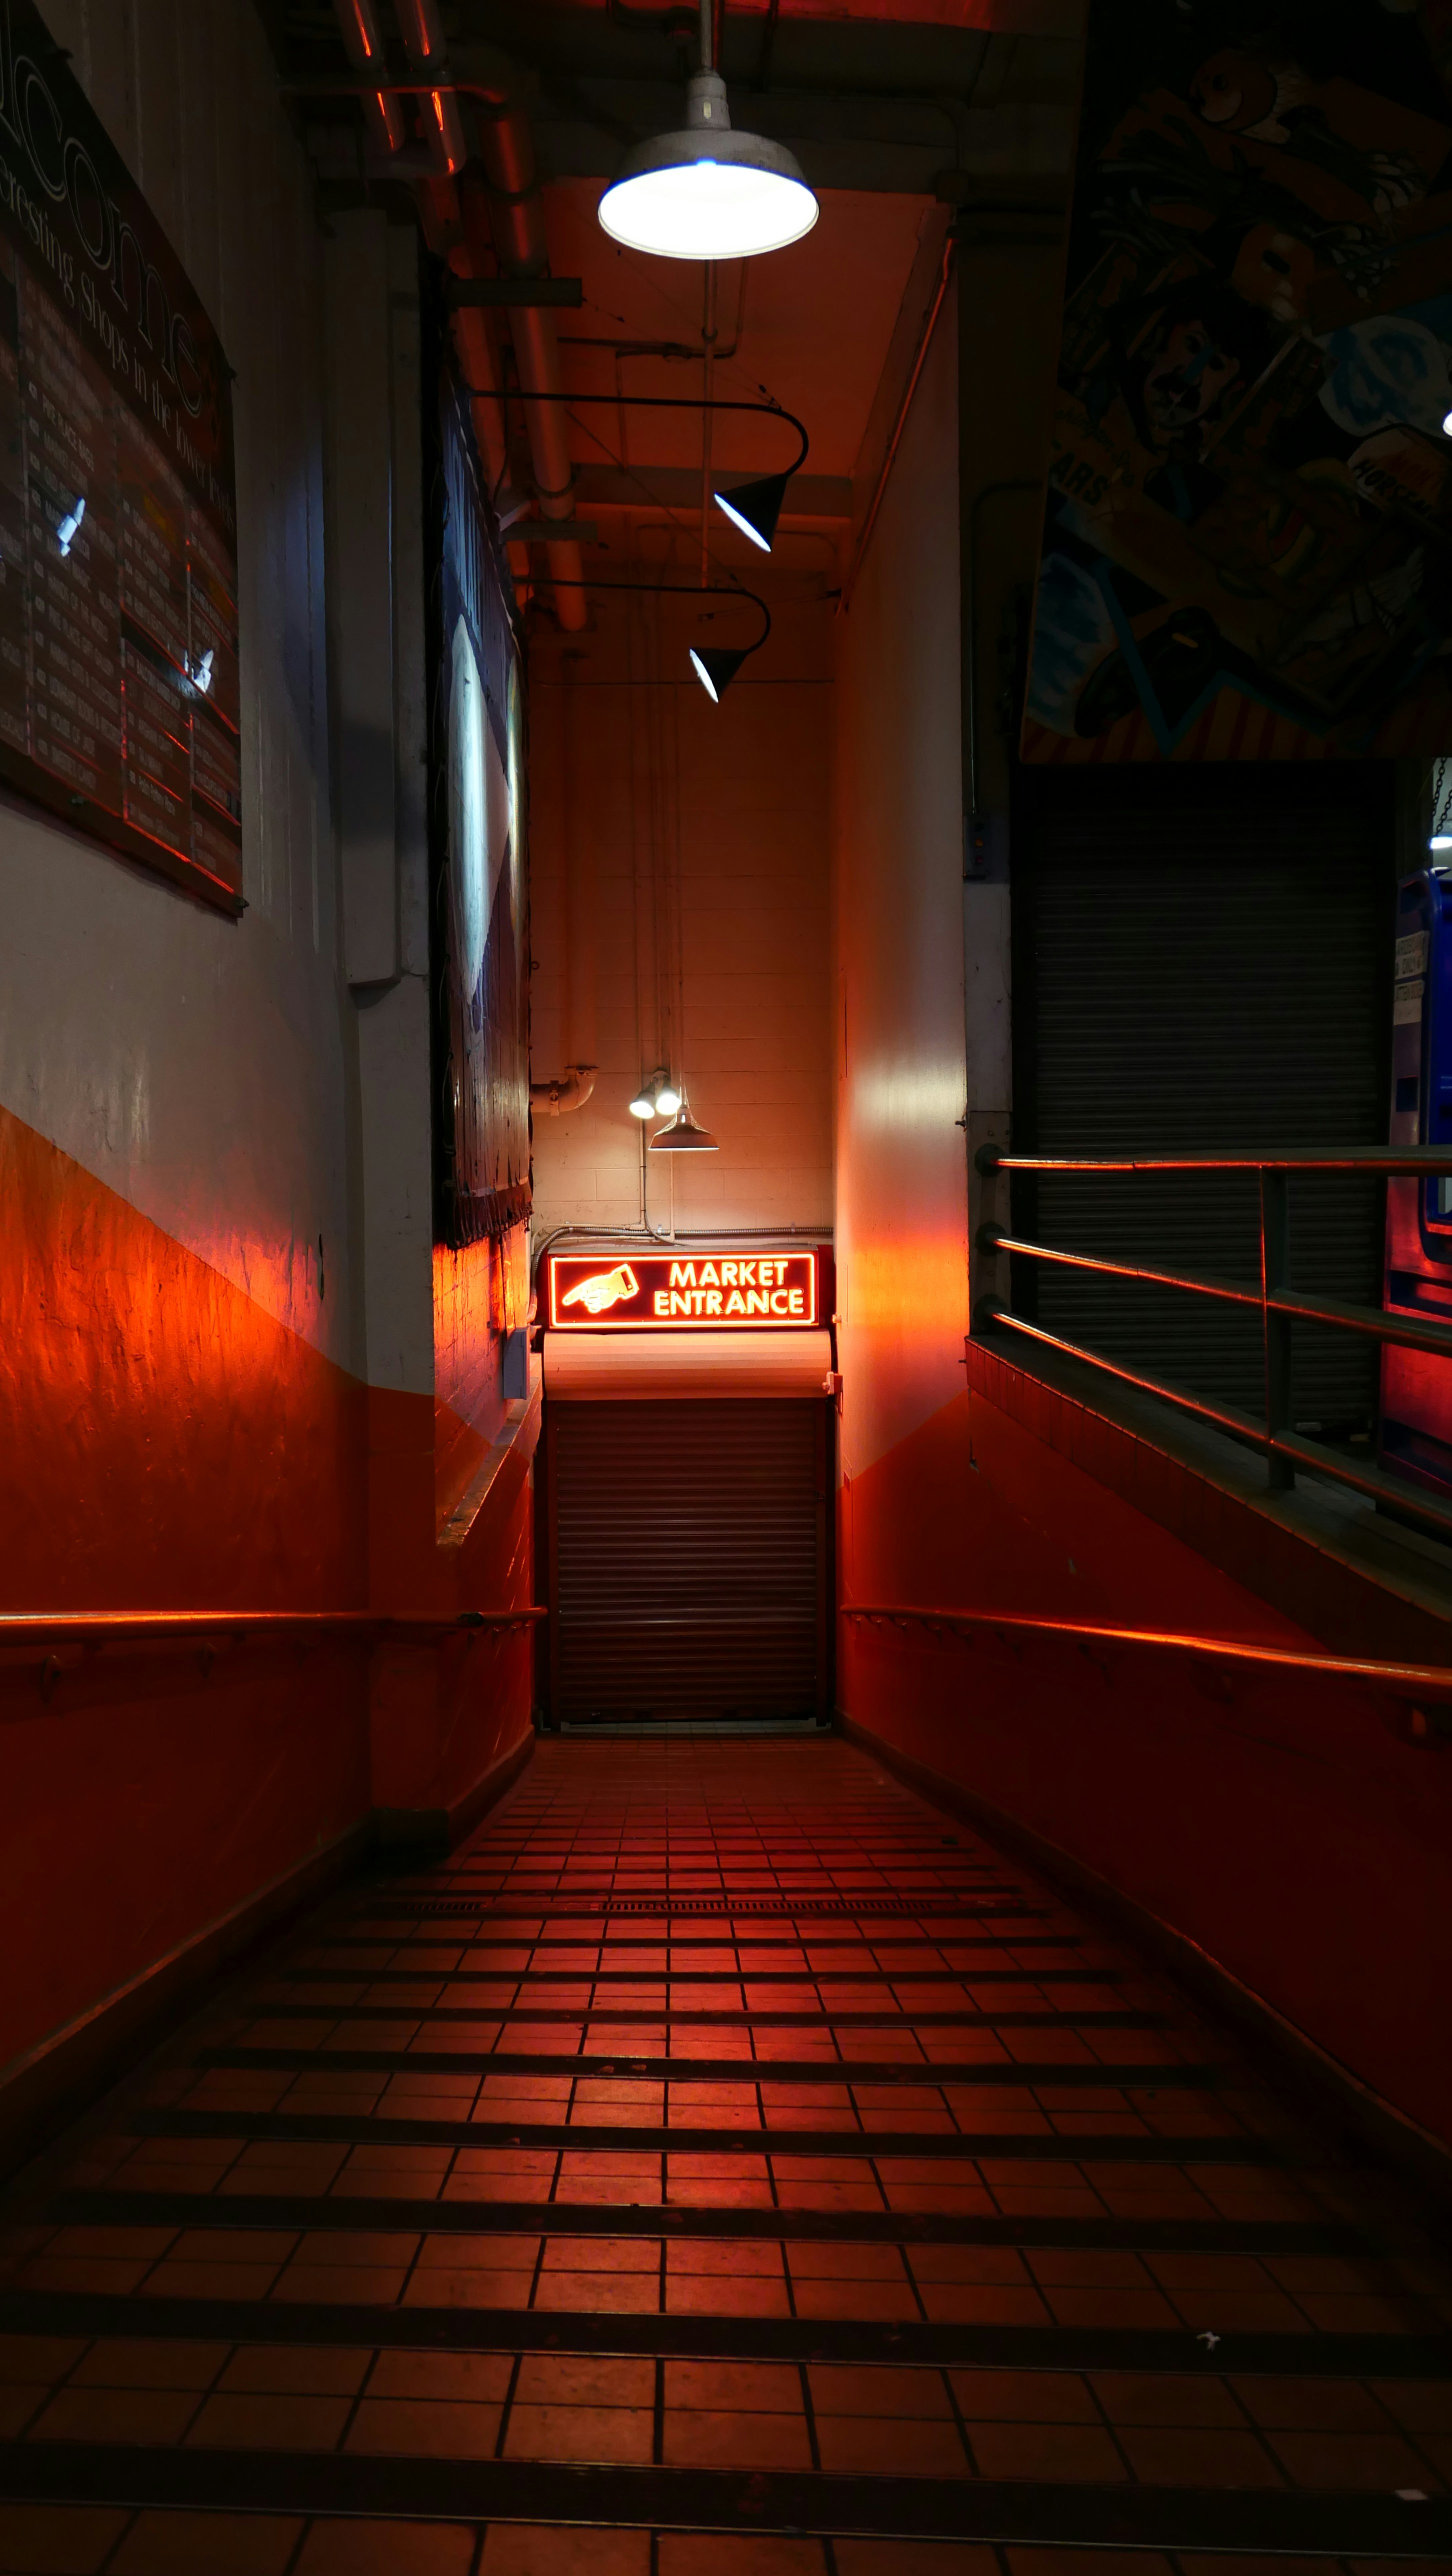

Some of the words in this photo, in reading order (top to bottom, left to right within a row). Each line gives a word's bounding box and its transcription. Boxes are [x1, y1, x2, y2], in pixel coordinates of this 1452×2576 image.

[82, 272, 129, 374] Shops
[134, 346, 148, 404] in
[152, 379, 170, 438] the
[670, 1260, 788, 1288] MARKET
[654, 1288, 804, 1316] ENTRANCE
